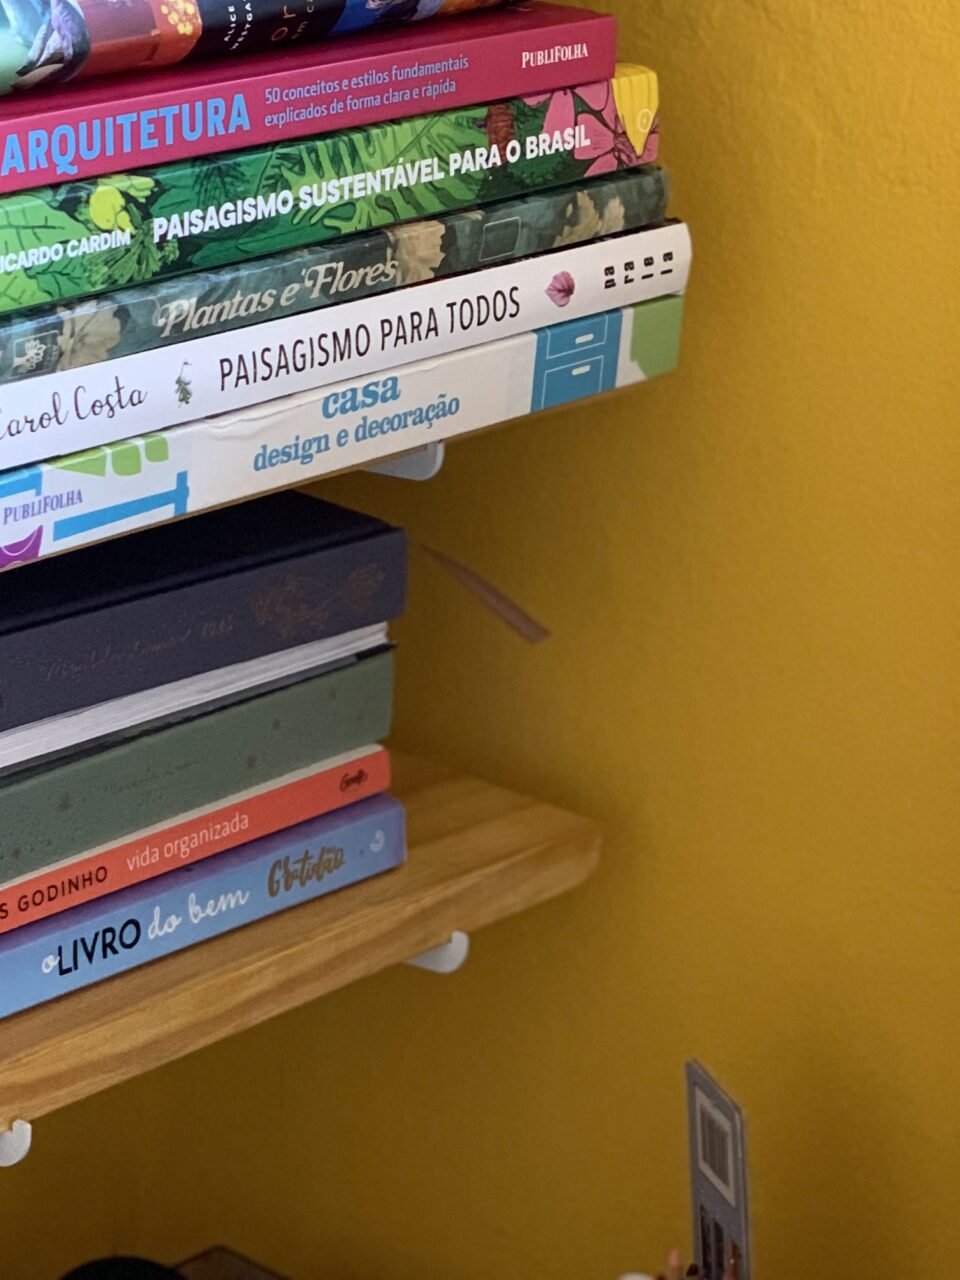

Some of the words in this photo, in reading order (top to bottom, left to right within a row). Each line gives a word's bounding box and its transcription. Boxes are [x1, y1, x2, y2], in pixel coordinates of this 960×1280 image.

[265, 88, 281, 106] 50
[282, 79, 340, 102] conceitos
[341, 80, 349, 91] e
[350, 69, 390, 91] estilos
[391, 54, 470, 83] fundamentais
[265, 104, 327, 128] explicados
[330, 97, 344, 112] de
[346, 89, 382, 111] forma
[383, 85, 411, 104] clara
[412, 88, 420, 98] e
[421, 78, 457, 100] rápida
[0, 91, 252, 178] ARQUITETURA
[152, 189, 294, 243] PAISAGISMO
[298, 155, 445, 213] SUSTENTÁVEL
[448, 143, 503, 177] PARA
[505, 141, 523, 165] O
[525, 123, 592, 161] BRASIL
[66, 228, 131, 260] CARDIM
[151, 281, 276, 339] Plantas
[279, 285, 299, 307] e
[298, 253, 399, 302] Flores
[219, 311, 371, 393] PAISAGISMO
[380, 302, 440, 341] PARA
[445, 284, 522, 335] TODOS
[73, 375, 148, 420] Costa
[321, 374, 402, 420] casa
[253, 431, 331, 472] design
[335, 427, 350, 447] e
[353, 394, 461, 440] decoração
[125, 846, 161, 873] vida
[163, 811, 251, 861] organizada
[17, 864, 110, 914] GODINHO
[57, 918, 142, 977] LIVRO
[147, 904, 182, 941] do
[188, 887, 251, 924] bem
